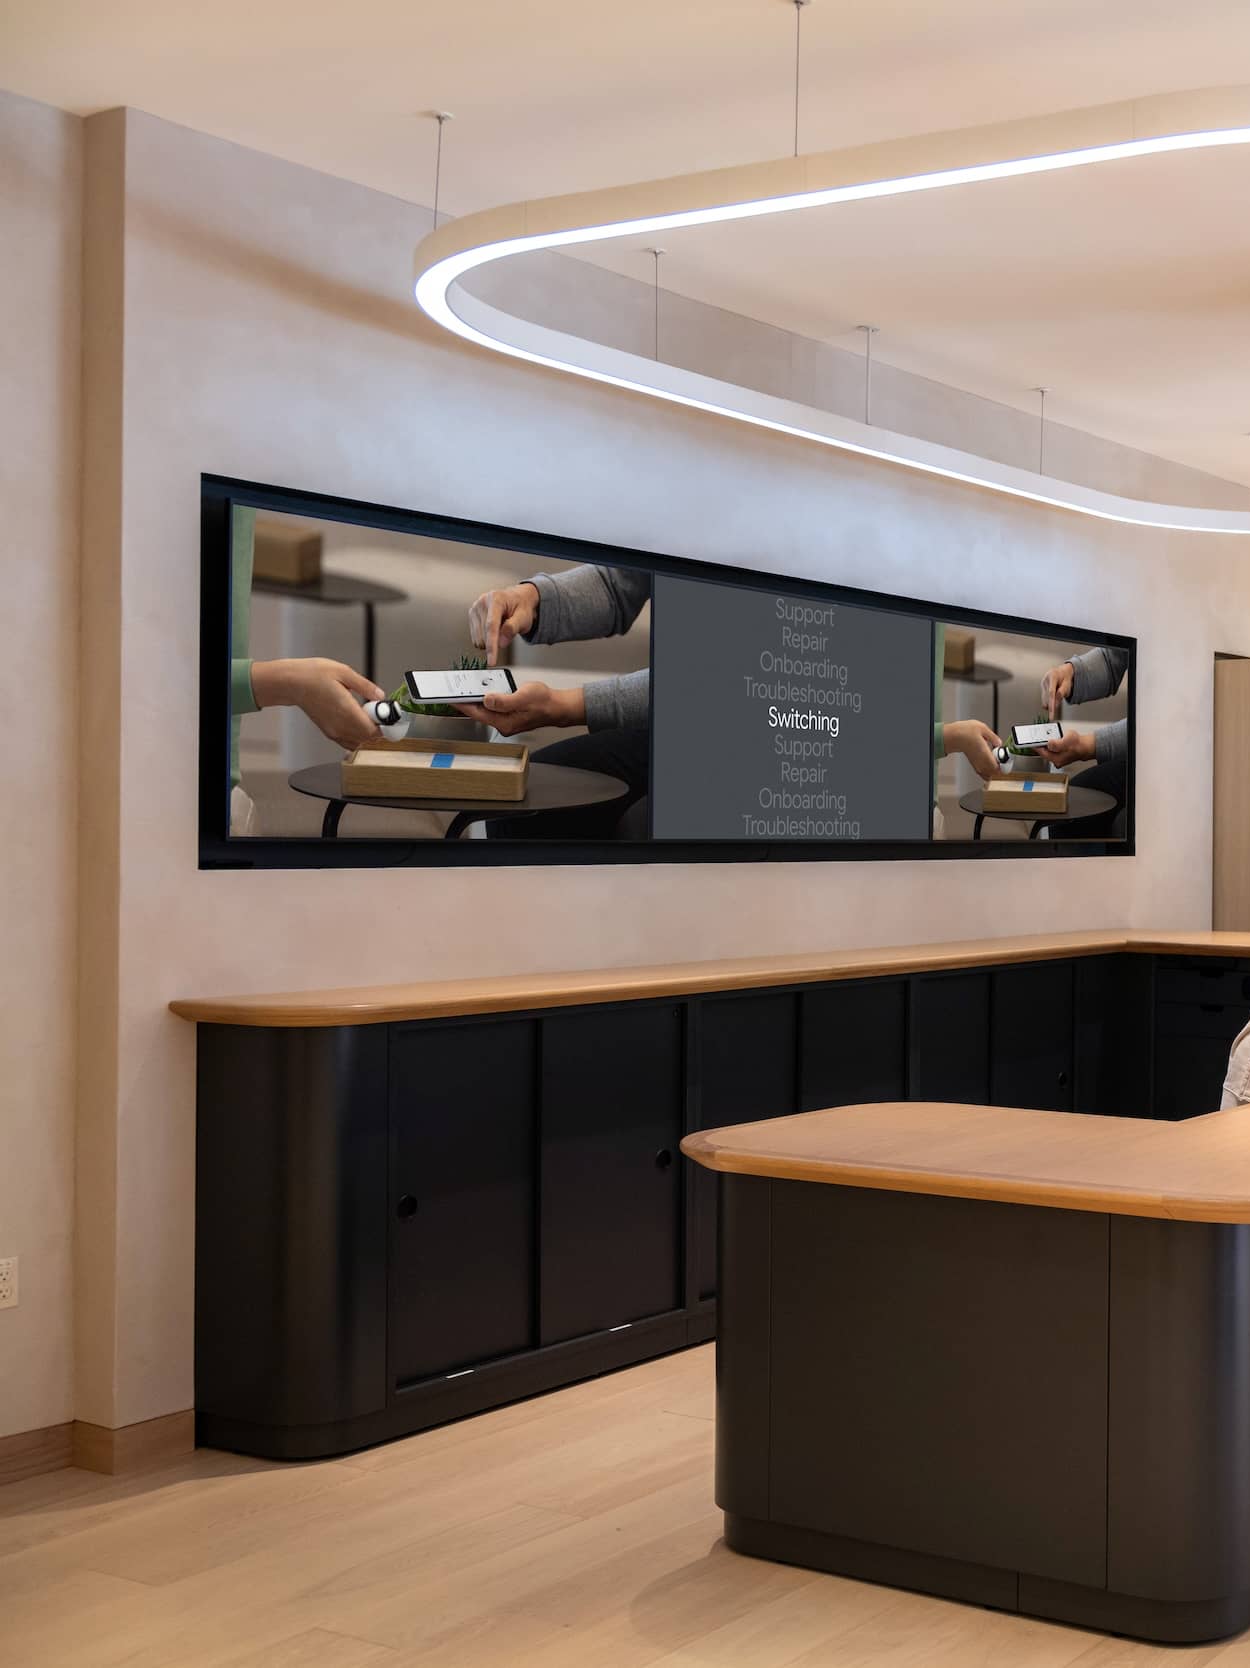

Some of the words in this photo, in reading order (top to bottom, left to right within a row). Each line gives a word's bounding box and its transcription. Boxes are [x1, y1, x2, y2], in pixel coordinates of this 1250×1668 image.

[775, 597, 835, 628] Support
[781, 625, 829, 654] Repair
[759, 650, 849, 686] Onboarding
[743, 676, 863, 713] Troubleshooting
[767, 705, 840, 738] Switching
[774, 733, 834, 761] Support
[780, 761, 828, 787] Repair
[758, 787, 848, 816] Onboarding
[742, 814, 861, 840] Troubleshooting
